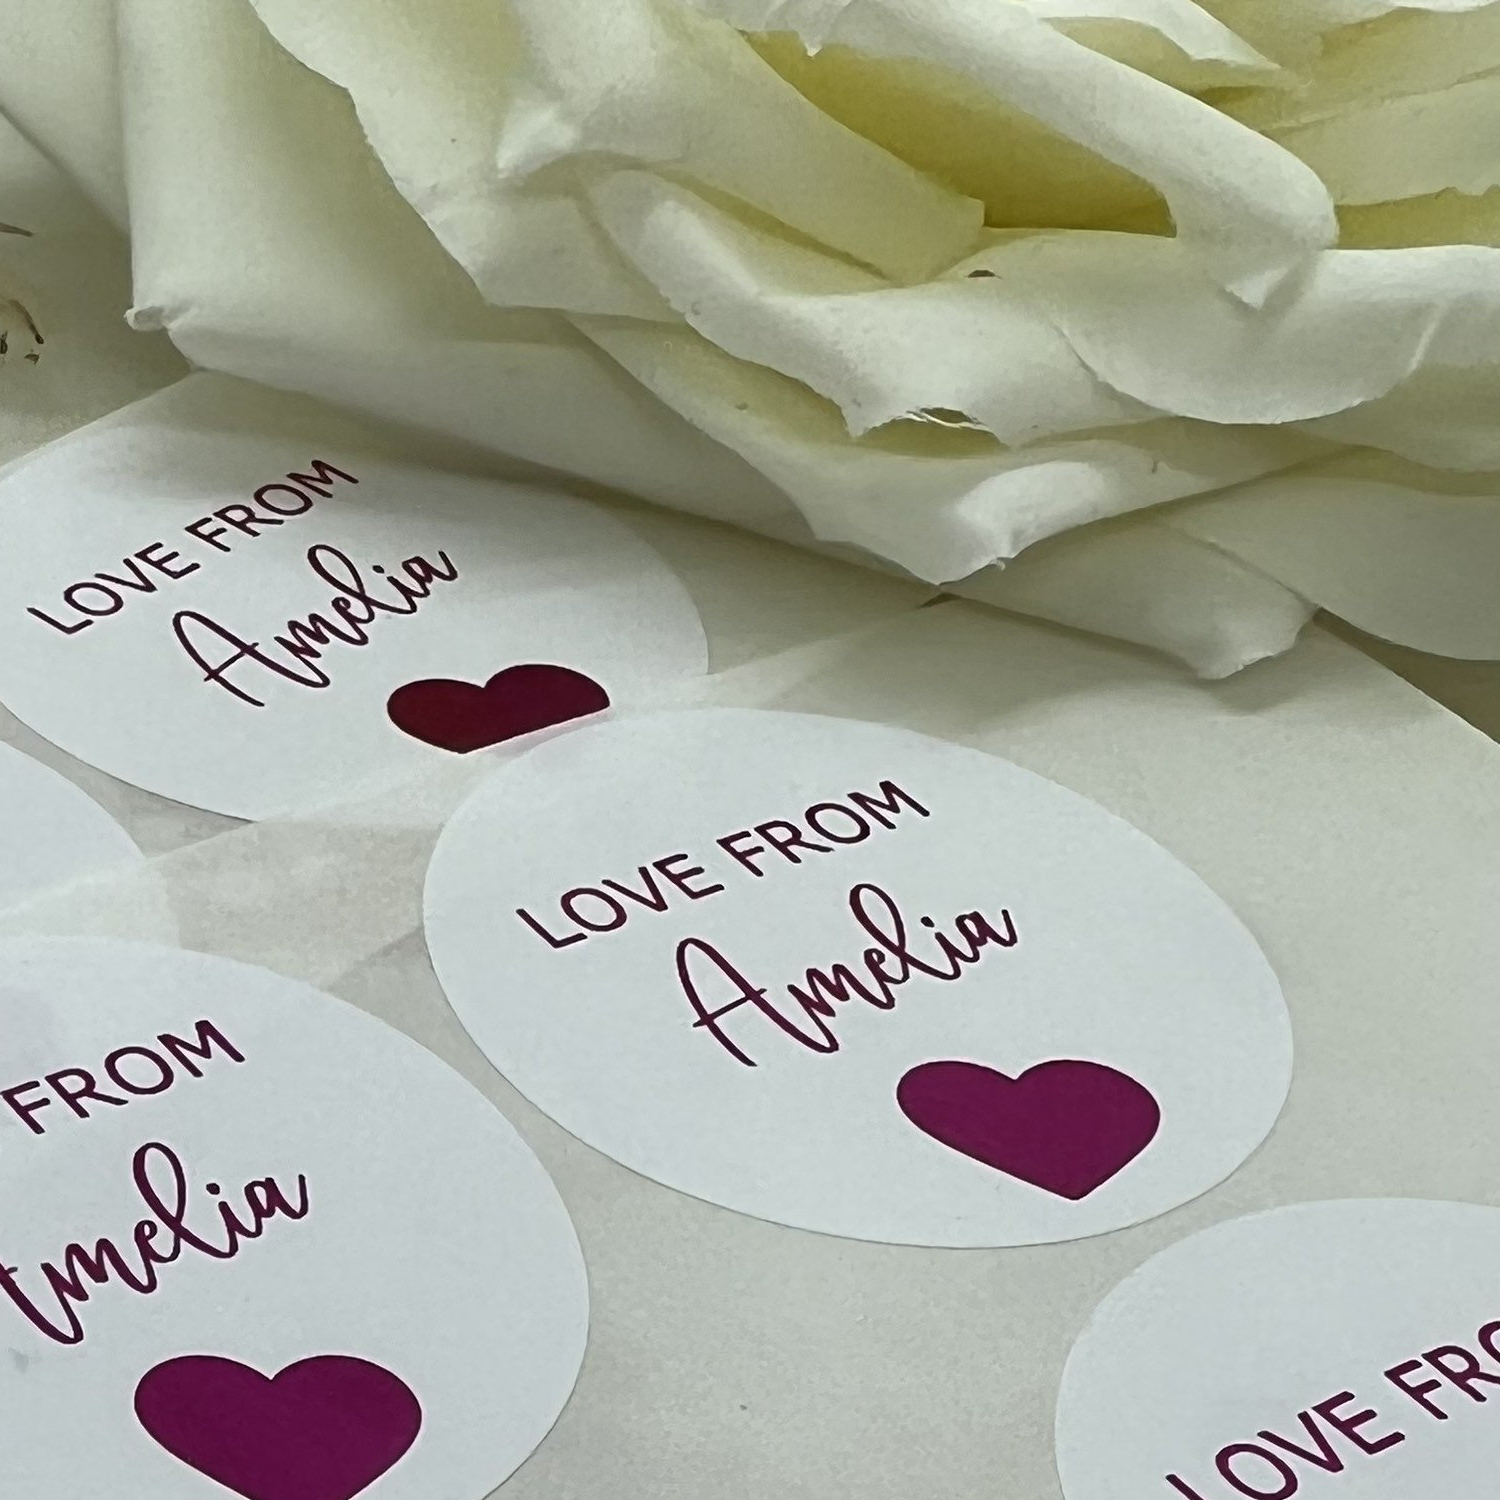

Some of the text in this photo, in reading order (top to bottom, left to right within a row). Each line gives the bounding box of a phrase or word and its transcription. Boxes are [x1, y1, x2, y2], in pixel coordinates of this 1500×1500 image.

[27, 460, 359, 634] LOVE FROM
[172, 545, 457, 707] Amelia
[518, 781, 930, 948] LOVE FROM
[676, 884, 1017, 1067] Amelia
[0, 1020, 245, 1134] FROM
[1384, 1321, 1500, 1420] FR
